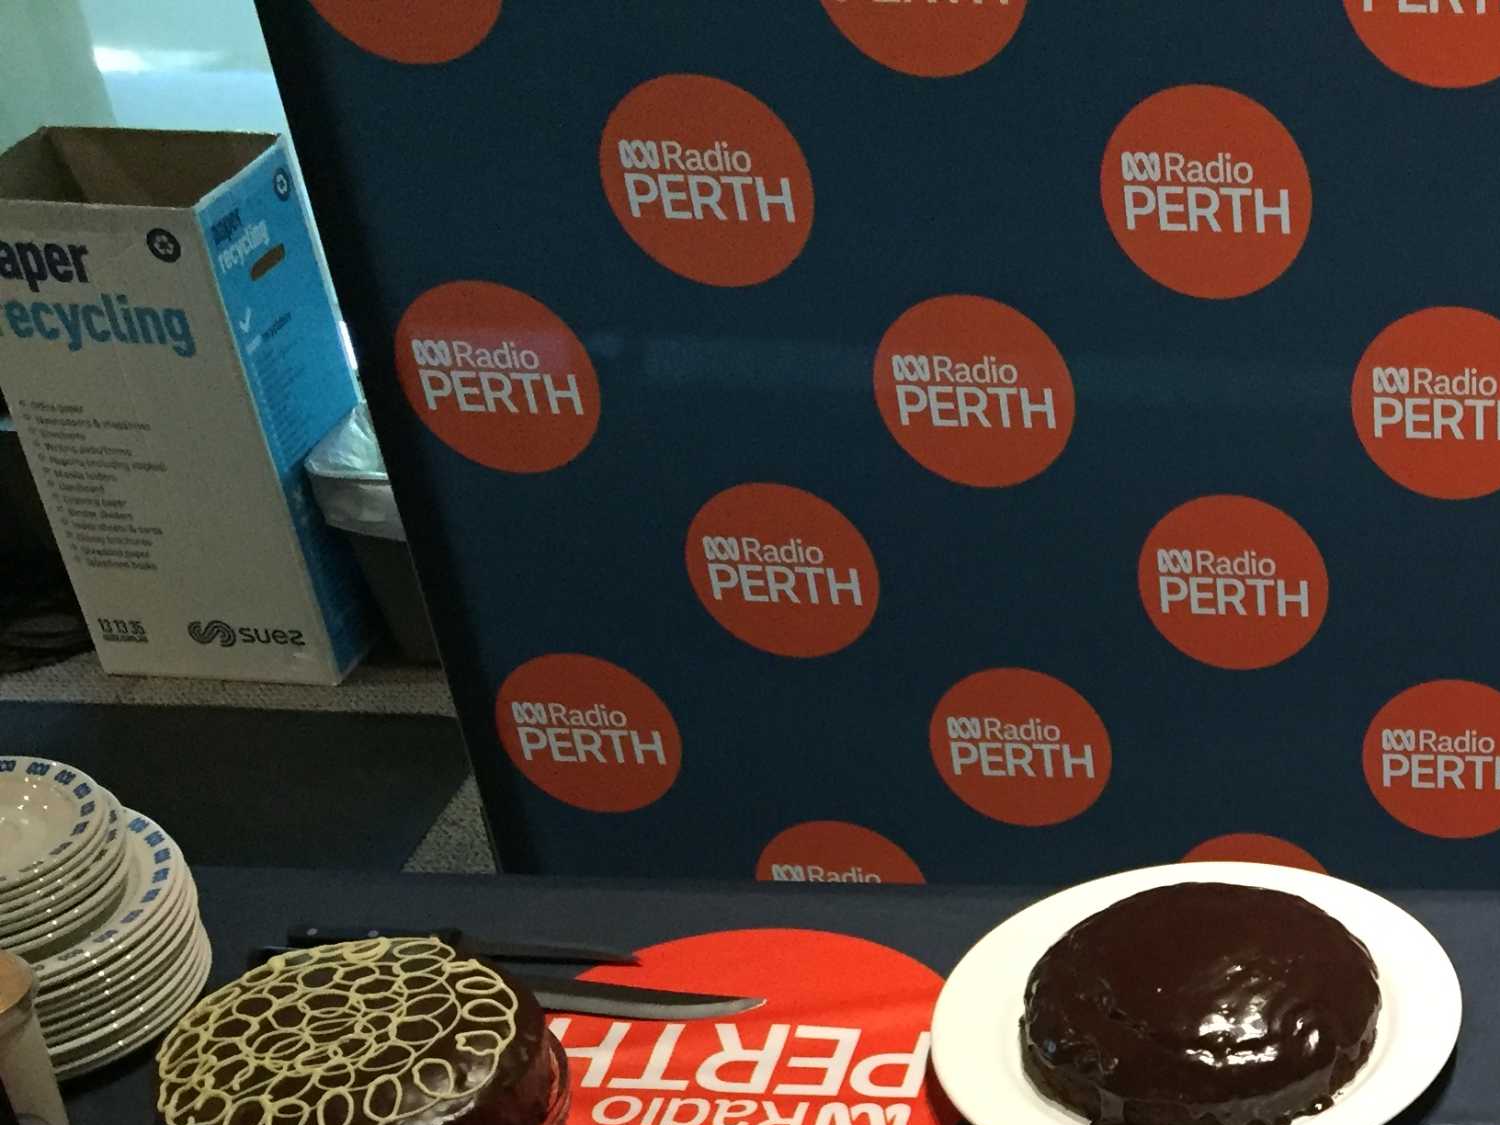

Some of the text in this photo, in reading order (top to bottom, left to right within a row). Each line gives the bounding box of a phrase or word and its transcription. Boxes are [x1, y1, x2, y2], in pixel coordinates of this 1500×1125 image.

[661, 140, 752, 173] Radio
[1164, 152, 1254, 184] Radio
[624, 172, 796, 224] PERTH
[1123, 185, 1291, 235] PERTH
[0, 293, 197, 358] ecycling
[452, 340, 541, 370] Radio
[932, 355, 1018, 384] Radio
[418, 369, 584, 415] PERTH
[1413, 367, 1498, 396] Radio
[896, 384, 1057, 430] PERTH
[741, 536, 825, 565] Radio
[1196, 549, 1277, 577] Radio
[707, 563, 863, 606] PERTH
[1158, 576, 1310, 618] PERTH
[238, 627, 306, 646] suez
[548, 702, 628, 727] Radio
[983, 716, 1062, 742] Radio
[516, 726, 667, 765] PERTH
[1419, 728, 1496, 754] Radio
[950, 741, 1096, 779] PERTH
